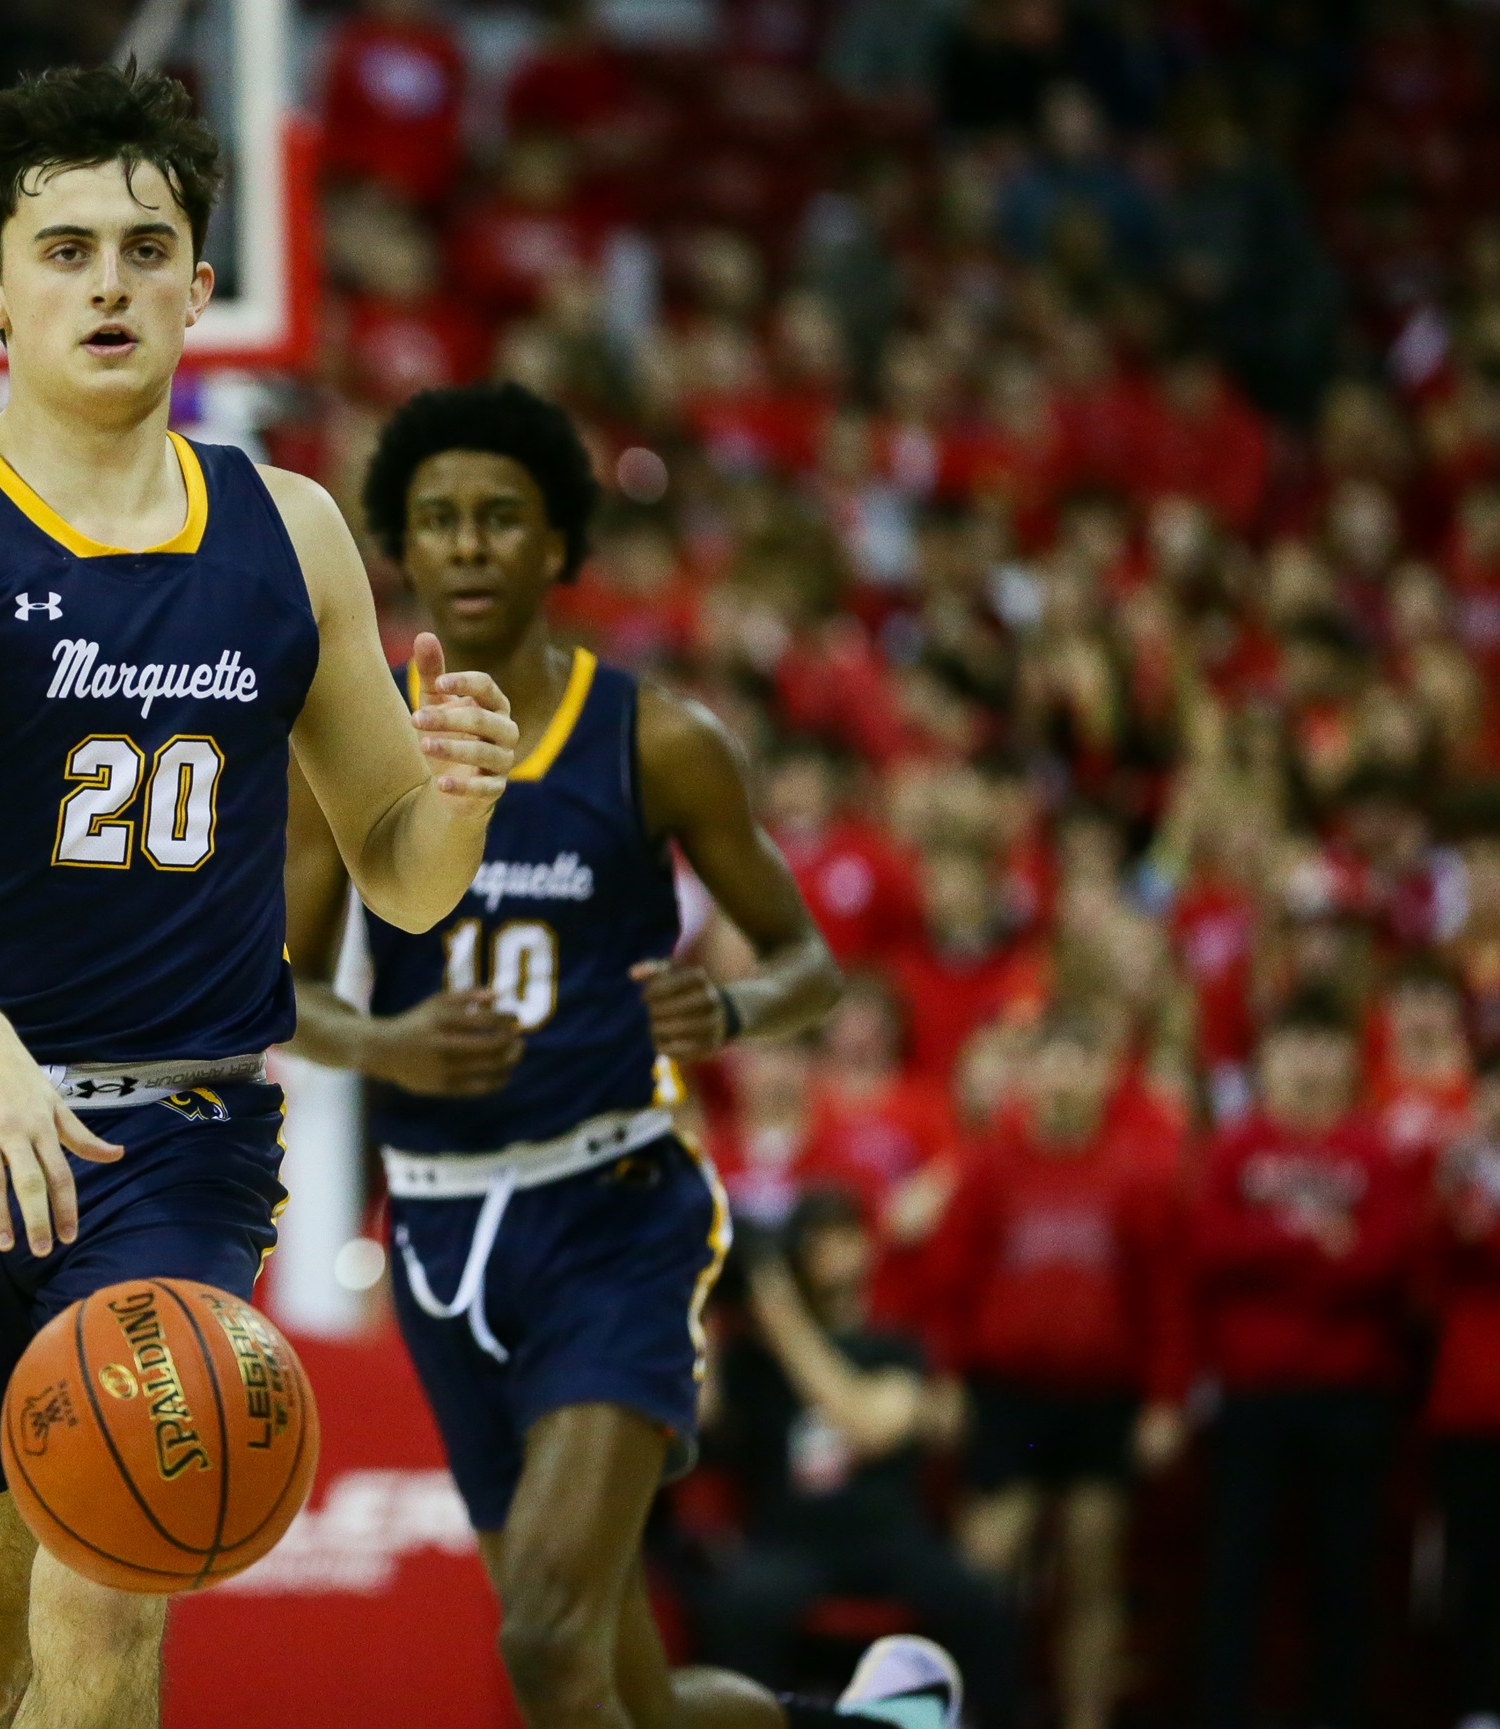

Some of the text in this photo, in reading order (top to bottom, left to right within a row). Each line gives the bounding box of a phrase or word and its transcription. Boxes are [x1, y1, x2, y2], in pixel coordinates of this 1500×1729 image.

[46, 638, 258, 719] Marquette
[51, 733, 226, 872] 20
[441, 918, 559, 1033] 10
[144, 1067, 223, 1090] ARMOUR
[108, 1290, 213, 1481] SPALDING
